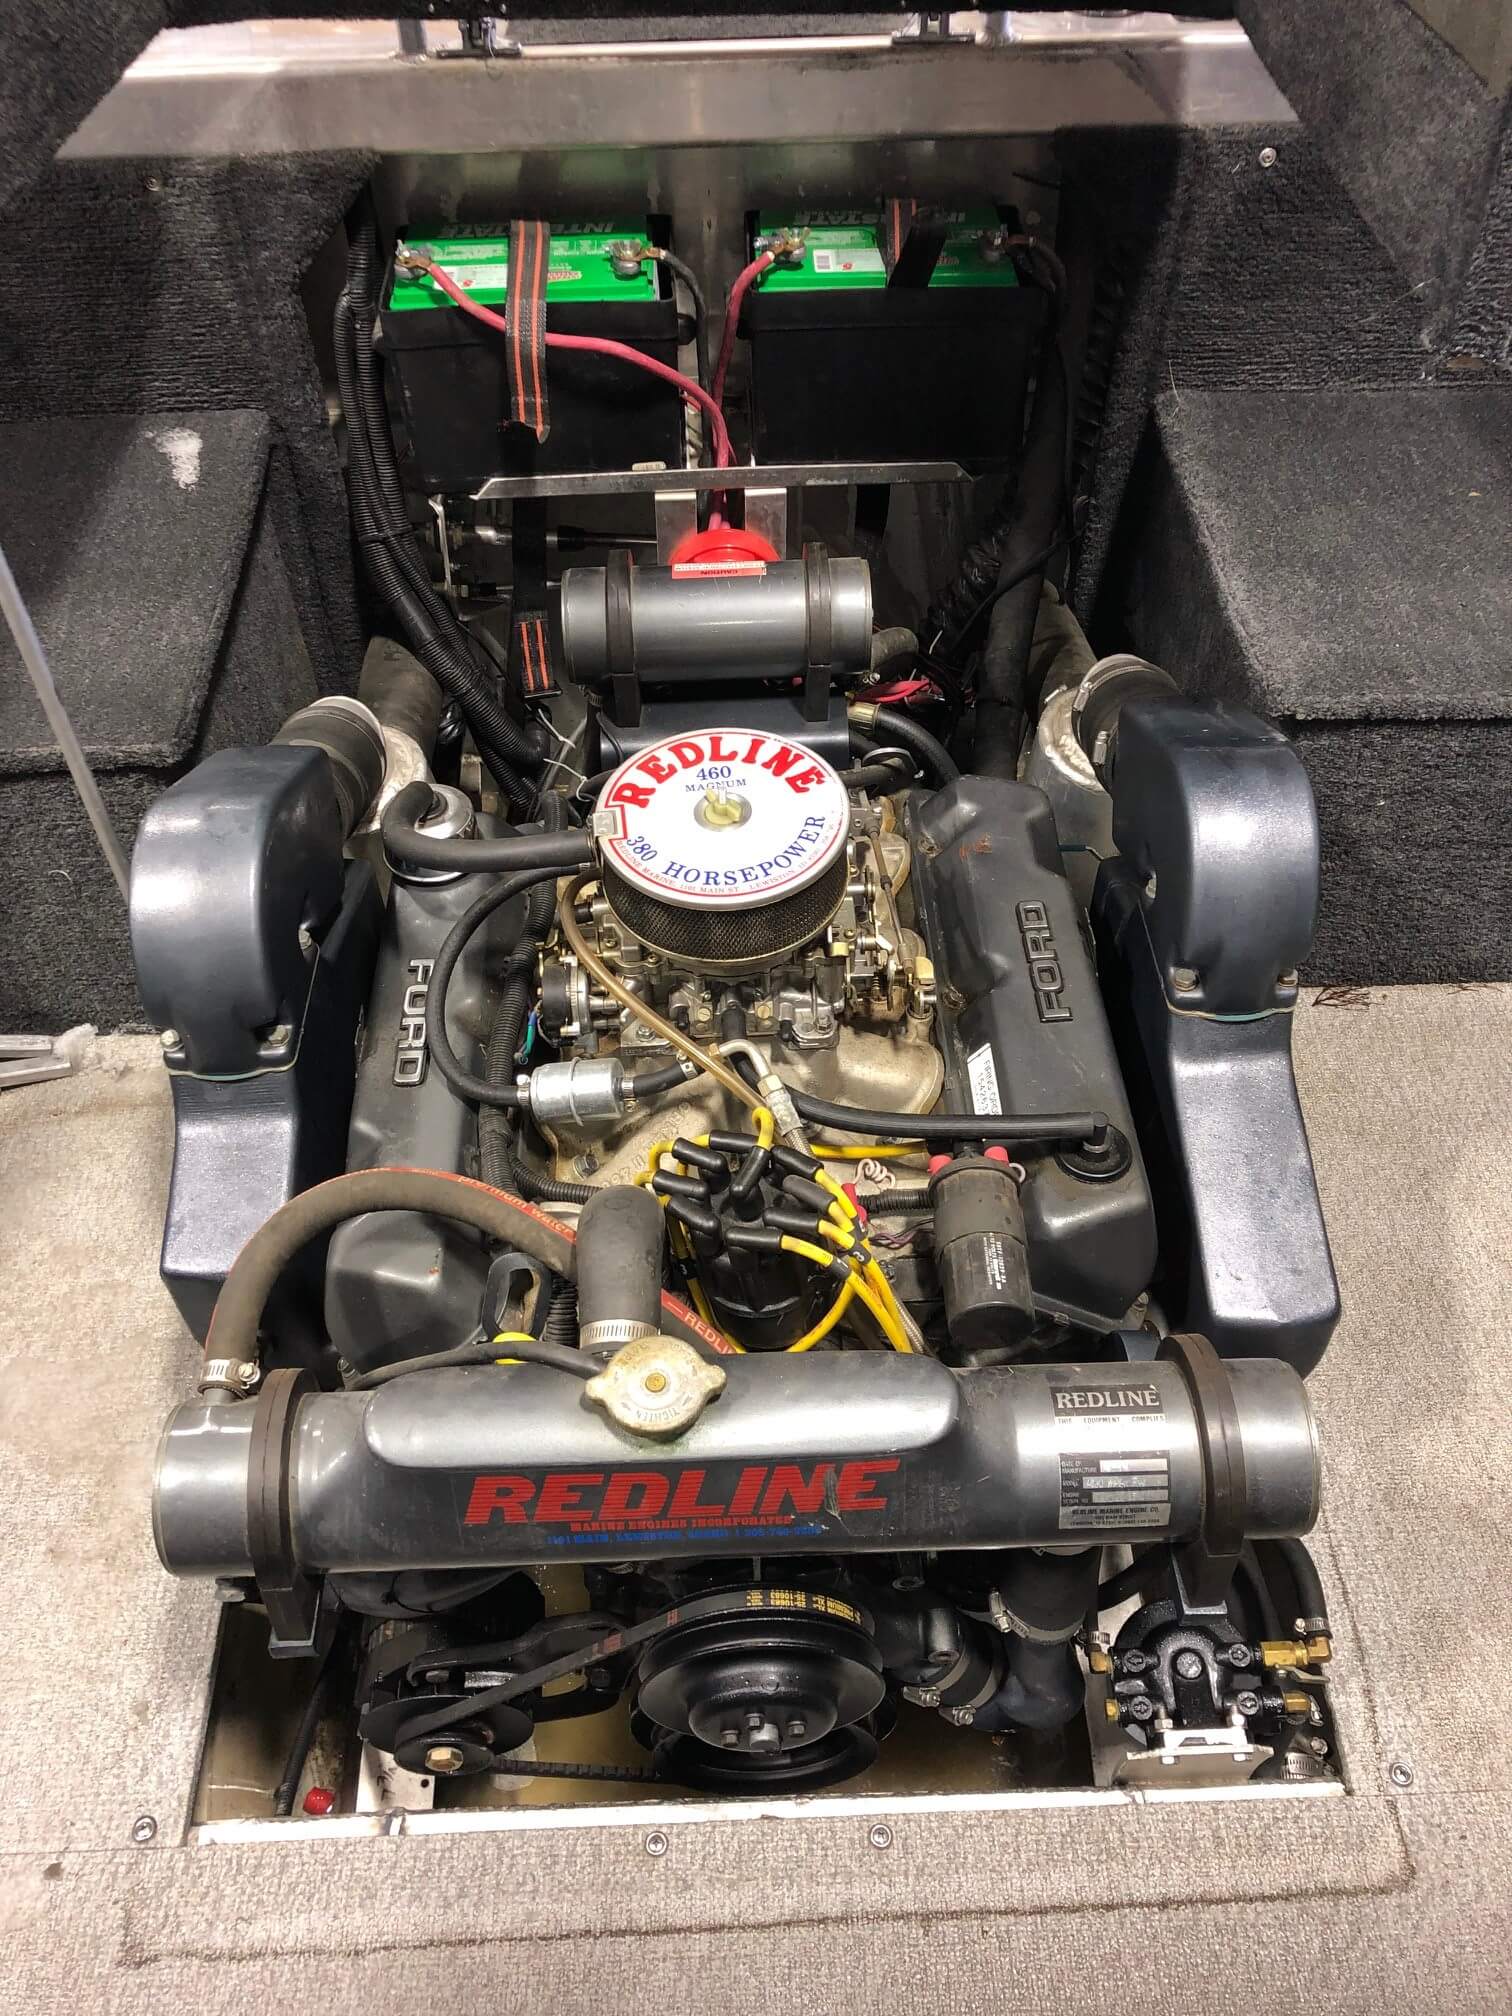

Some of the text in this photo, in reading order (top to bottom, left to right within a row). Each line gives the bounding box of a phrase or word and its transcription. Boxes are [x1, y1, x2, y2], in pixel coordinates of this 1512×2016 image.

[612, 736, 826, 808] REDLINE
[685, 779, 747, 792] MAGNUM
[696, 765, 731, 781] 460
[627, 836, 658, 862] 380
[662, 815, 825, 886] HORSEPOWER
[1015, 900, 1073, 1023] FORD
[393, 958, 434, 1087] FORD
[1055, 1390, 1160, 1409] REDLINE
[463, 1458, 901, 1526] REDLINE
